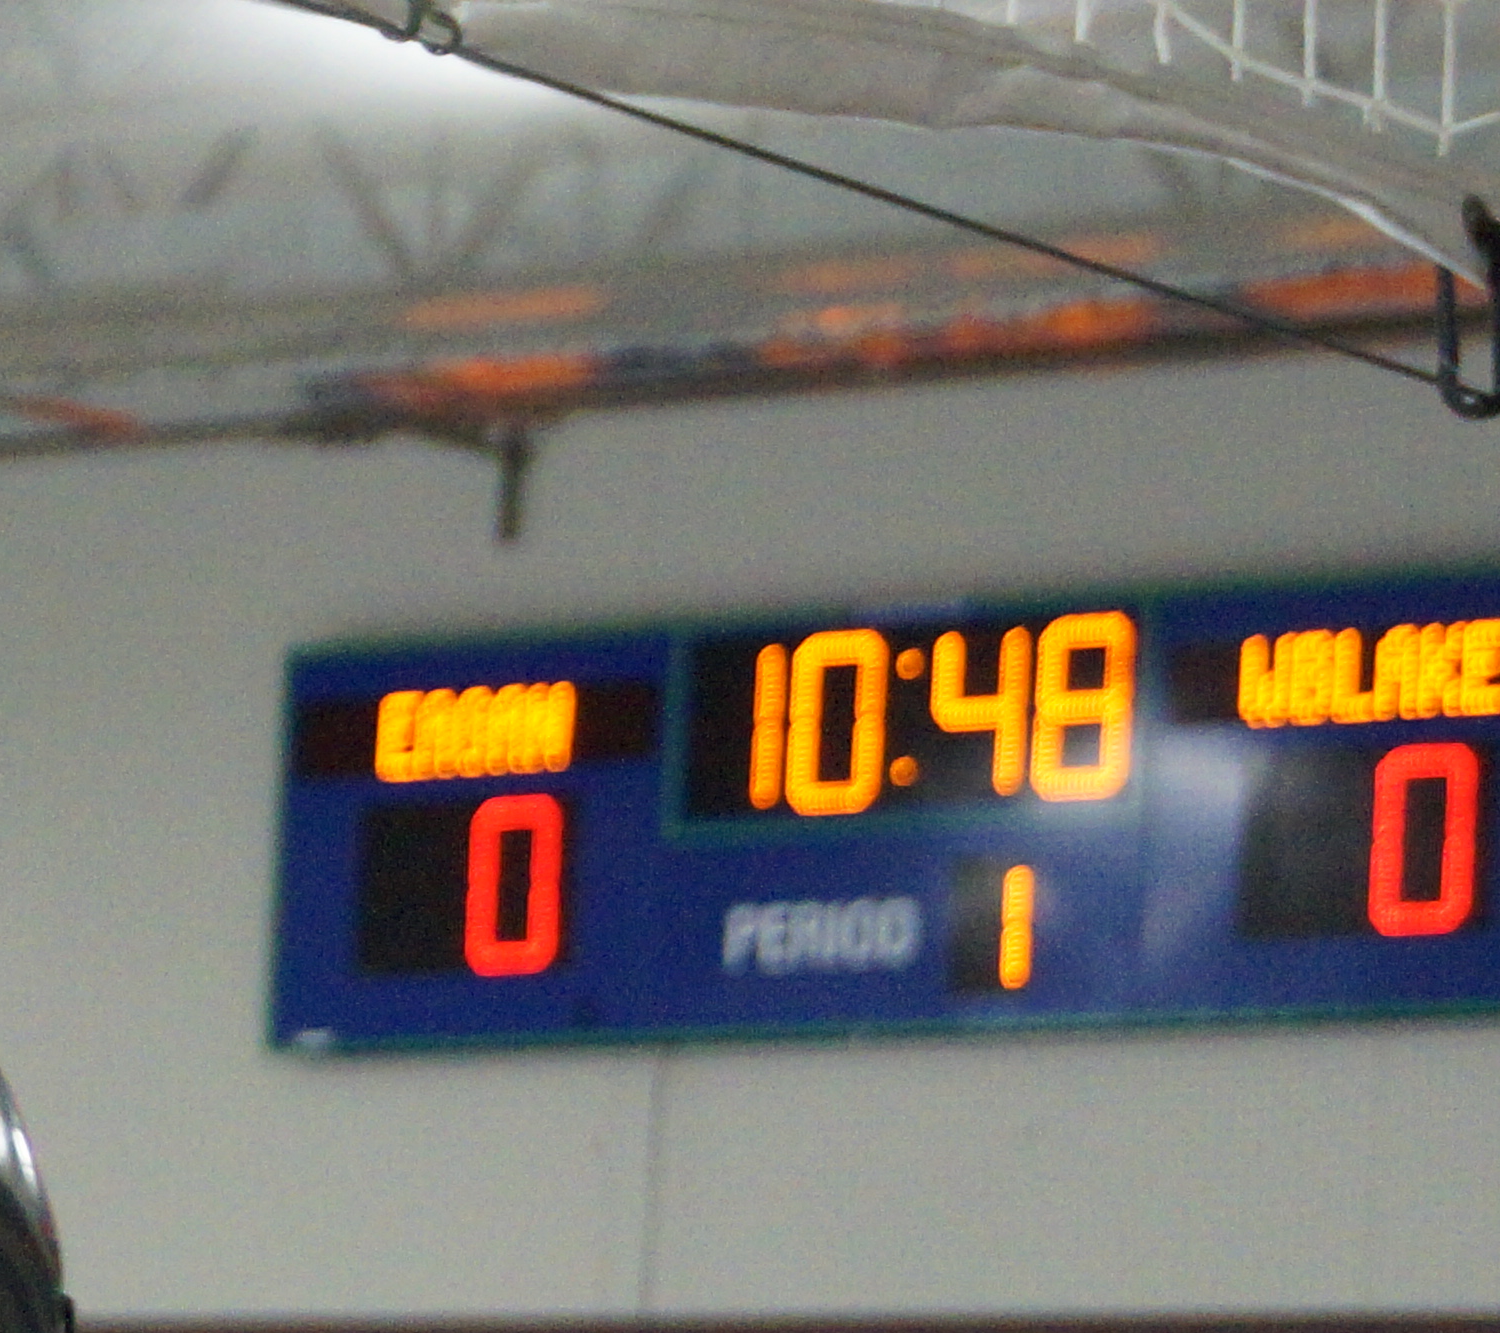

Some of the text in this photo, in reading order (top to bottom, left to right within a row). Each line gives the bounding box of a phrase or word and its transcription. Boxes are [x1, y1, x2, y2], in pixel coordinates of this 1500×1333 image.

[748, 609, 1136, 817] 10:48
[463, 793, 563, 978] 0
[722, 864, 1035, 991] PERIOD 1
[1366, 741, 1479, 938] 0
